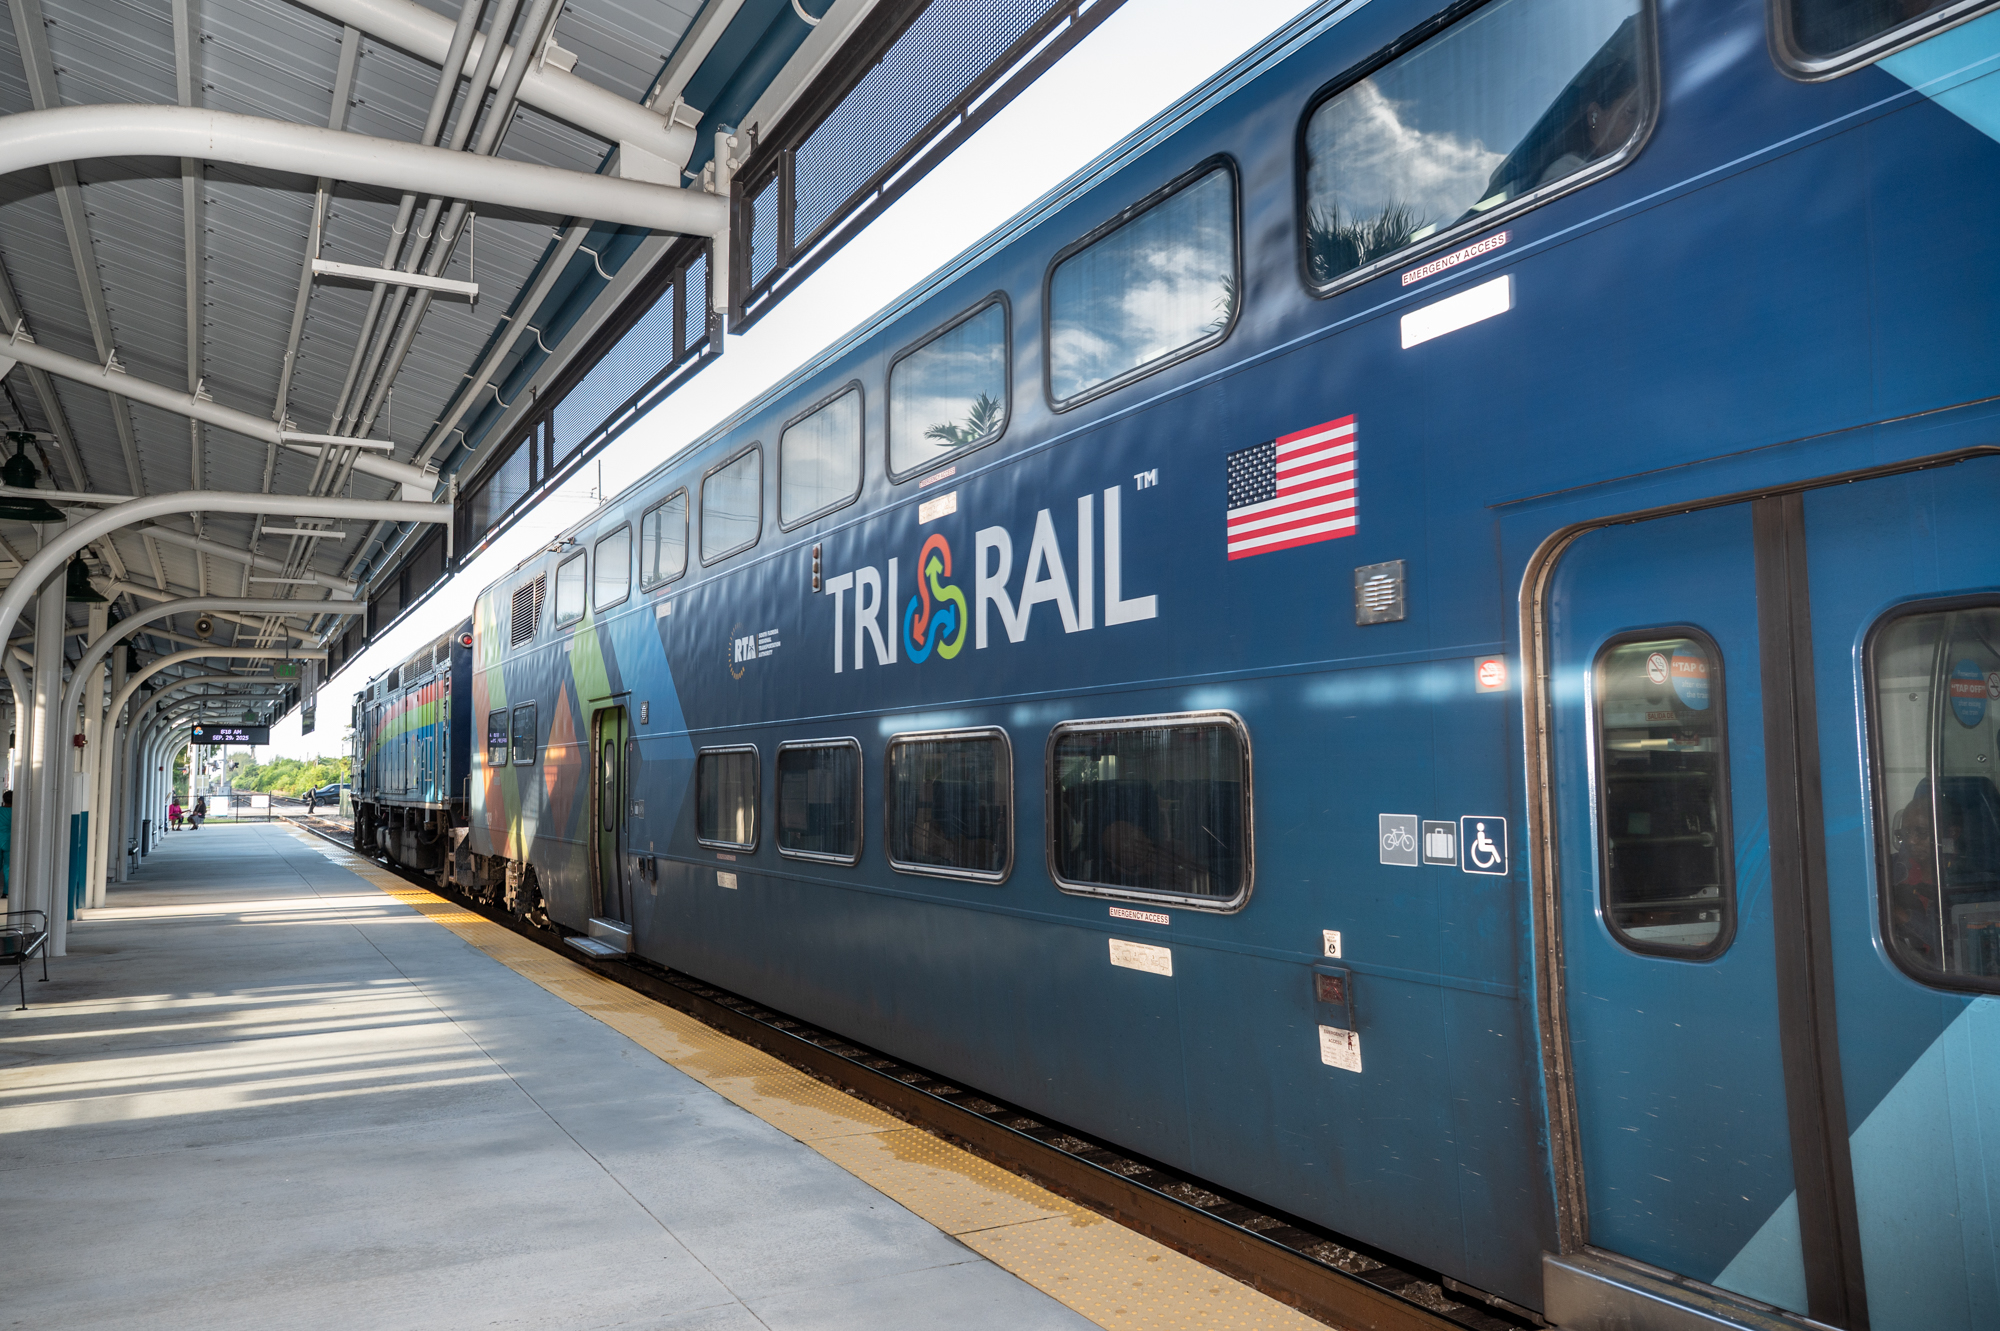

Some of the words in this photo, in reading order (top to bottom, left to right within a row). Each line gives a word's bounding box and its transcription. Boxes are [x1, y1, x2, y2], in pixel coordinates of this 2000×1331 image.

[1403, 252, 1461, 284] EMERGENCY
[1463, 234, 1505, 259] ACCESS
[825, 556, 898, 674] TRI
[975, 484, 1158, 650] RAIL
[734, 634, 757, 663] RTA
[279, 664, 296, 677] EXIT
[1647, 712, 1667, 720] SALIDA
[1110, 908, 1144, 920] EMERGENCY
[1144, 913, 1169, 924] ACCESS
